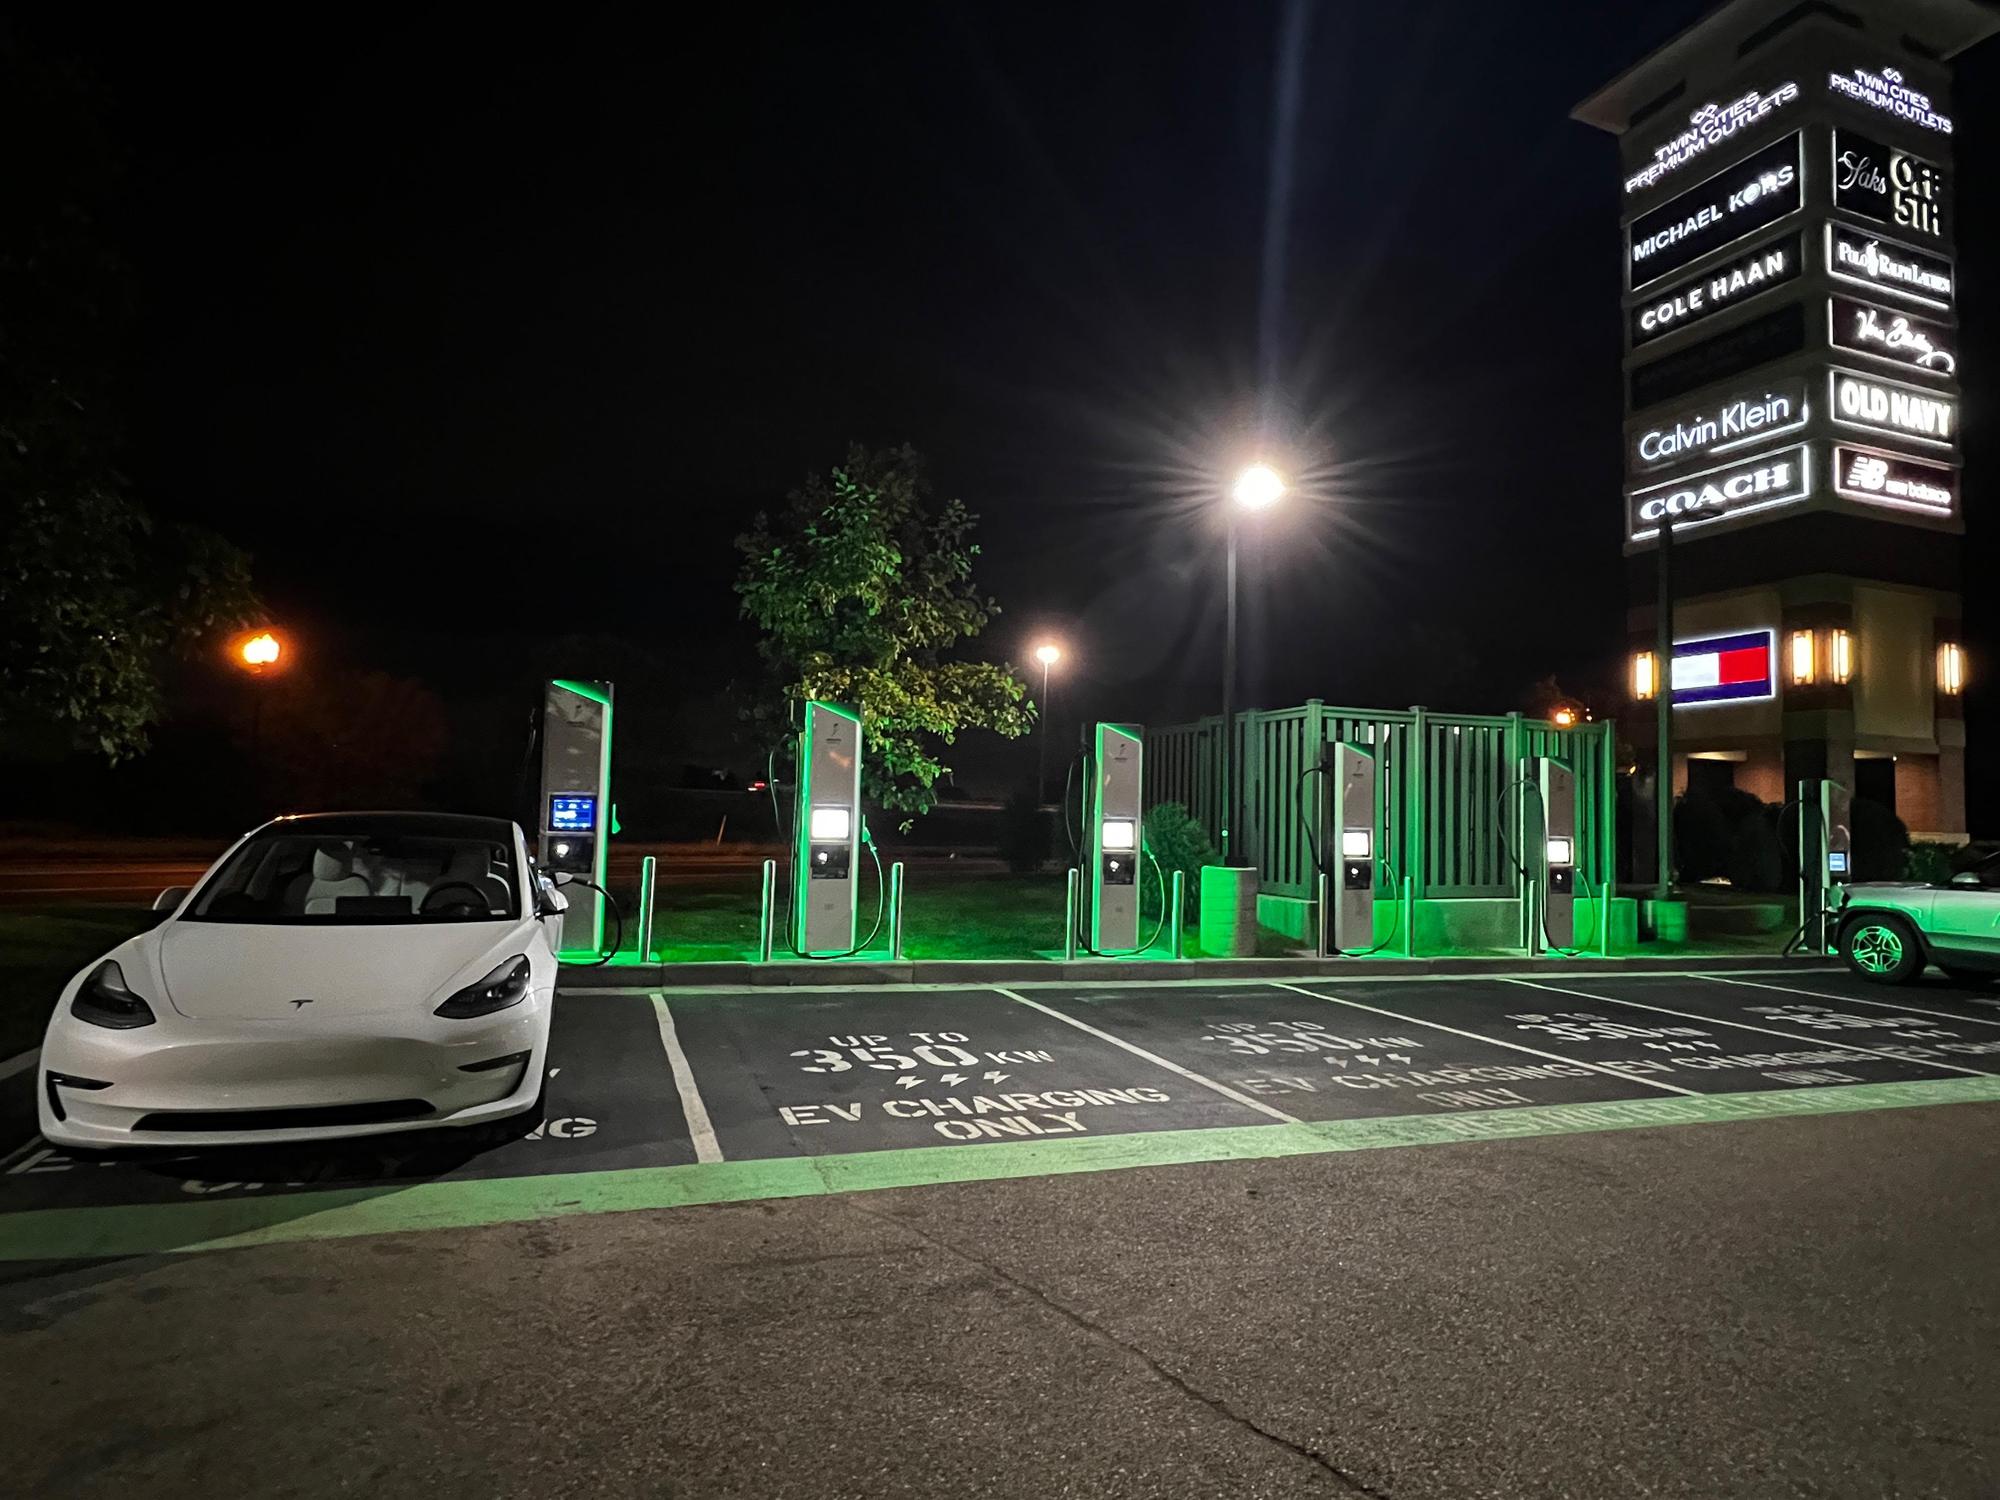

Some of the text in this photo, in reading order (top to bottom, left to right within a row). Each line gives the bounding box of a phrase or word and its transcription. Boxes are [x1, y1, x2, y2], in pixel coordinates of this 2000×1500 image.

[1830, 73, 1952, 134] PREMIUM OUTLETS
[1855, 69, 1931, 111] TWIN CITIES
[1625, 83, 1798, 193] PREMIUM OUTLETS
[1654, 91, 1760, 162] TWIN CITIES
[1838, 150, 1886, 195] Saks
[1633, 164, 1794, 262] MICHAEL KORS
[1640, 251, 1784, 331] COLE HAAN
[1639, 393, 1790, 461] Calvin Klein
[1840, 380, 1951, 437] OLD NAVY
[1639, 463, 1791, 520] COACH
[789, 1044, 1056, 1073] 350 KW
[829, 1031, 970, 1047] UP TO
[1200, 1031, 1365, 1055] 350
[1331, 1063, 1596, 1089] CHARGING
[779, 1088, 1171, 1126] EV CHARGING
[933, 1111, 1088, 1140] ONLY
